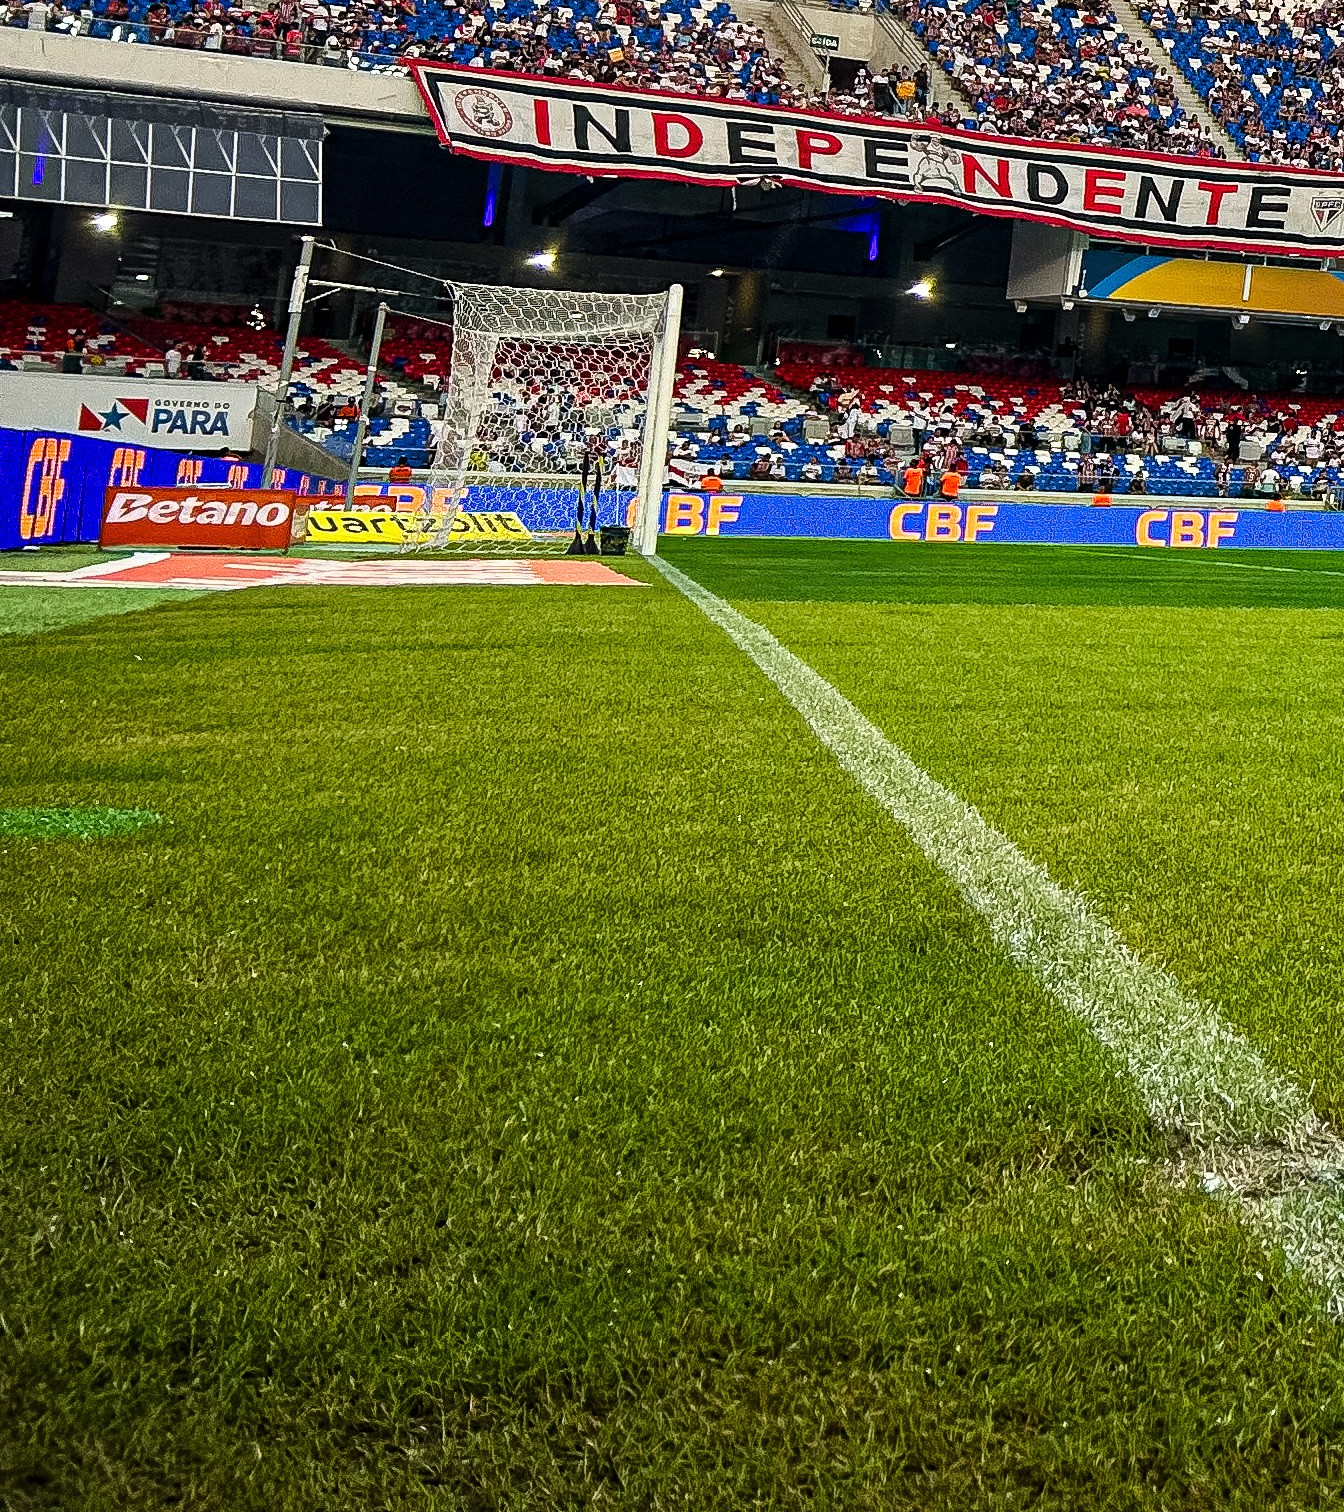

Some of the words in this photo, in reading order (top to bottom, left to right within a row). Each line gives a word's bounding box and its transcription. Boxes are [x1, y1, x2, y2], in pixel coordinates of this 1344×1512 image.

[533, 99, 1291, 228] INDEPENDENTE
[154, 398, 209, 409] GOVERNO
[214, 402, 230, 410] DO
[20, 438, 71, 539] CBF
[106, 492, 289, 526] Betano
[308, 514, 521, 535] uartzolit
[889, 503, 999, 542] CBF
[1135, 510, 1238, 548] CBF
